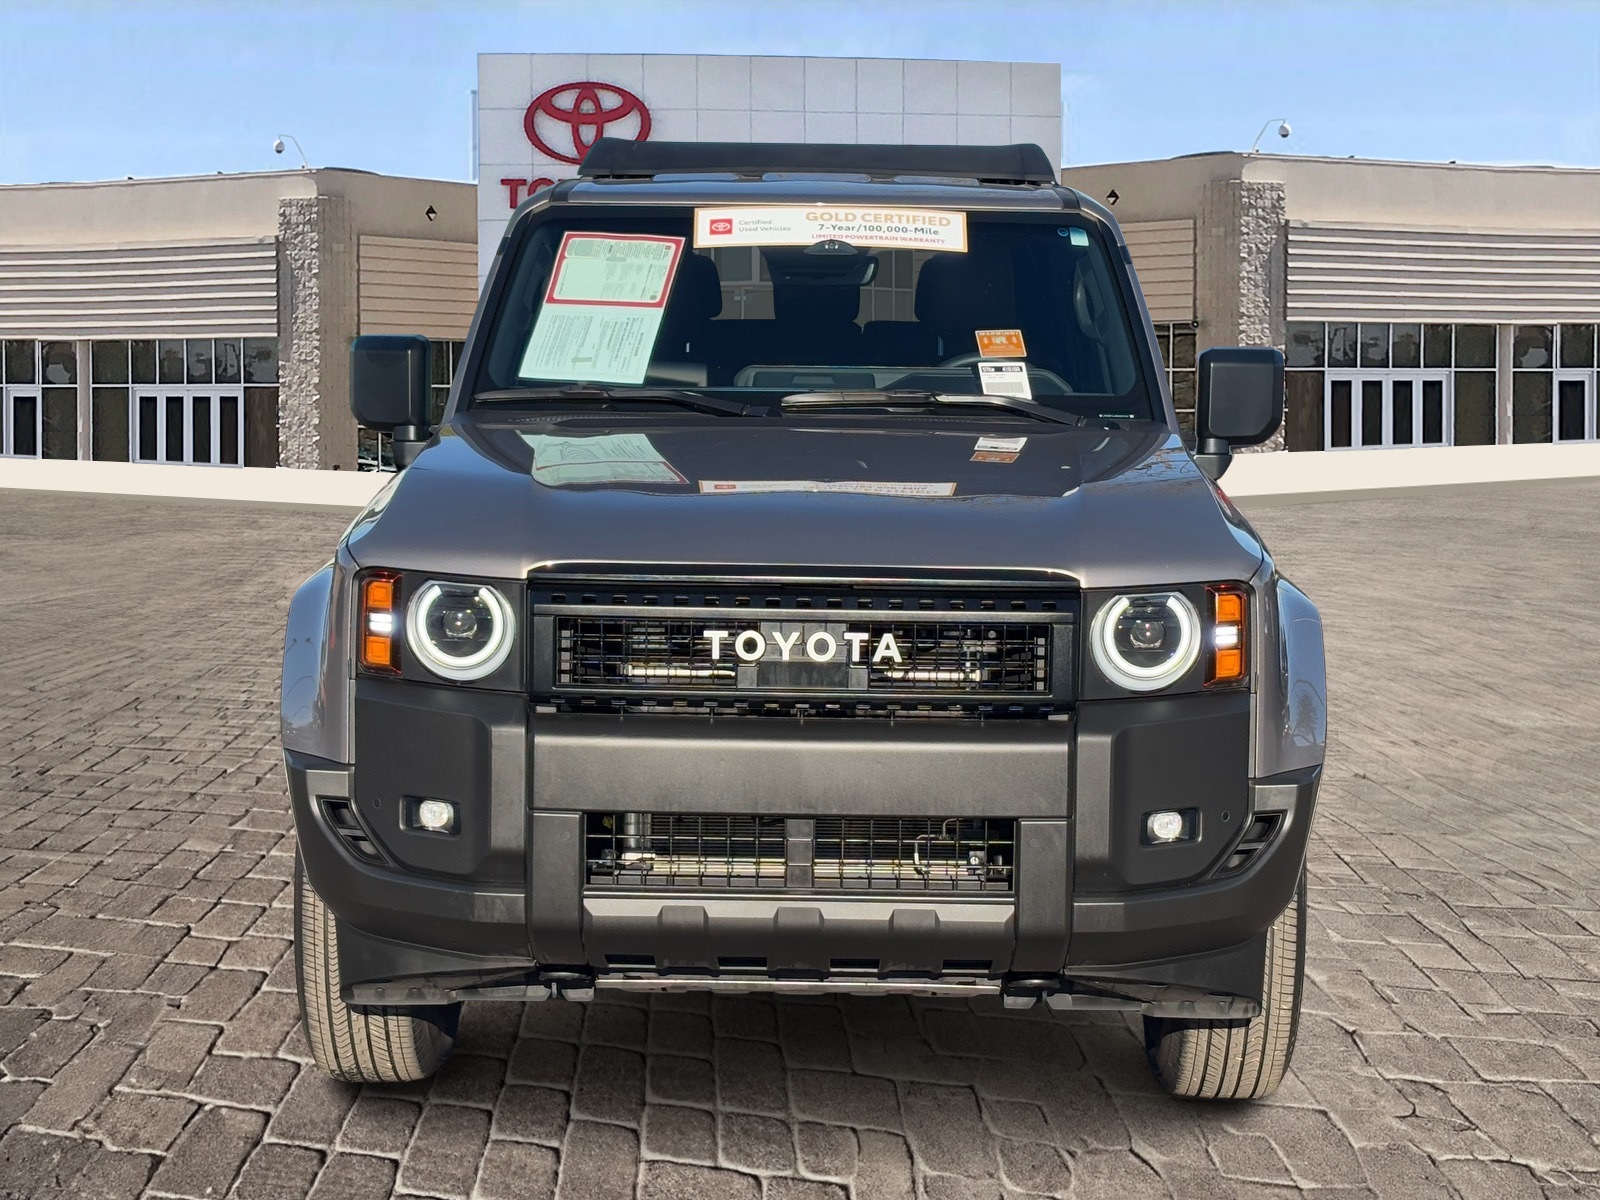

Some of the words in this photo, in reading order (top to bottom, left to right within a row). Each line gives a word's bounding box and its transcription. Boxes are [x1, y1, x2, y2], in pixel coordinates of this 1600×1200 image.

[805, 211, 857, 223] GOLD
[861, 212, 951, 227] CERTIFIED
[818, 223, 940, 236] 7-Year/100,000-Mile
[811, 233, 844, 241] LIMITED
[845, 234, 899, 242] POWERTRAIN
[899, 236, 946, 245] WARRANTY
[703, 629, 903, 663] TOYOTA
